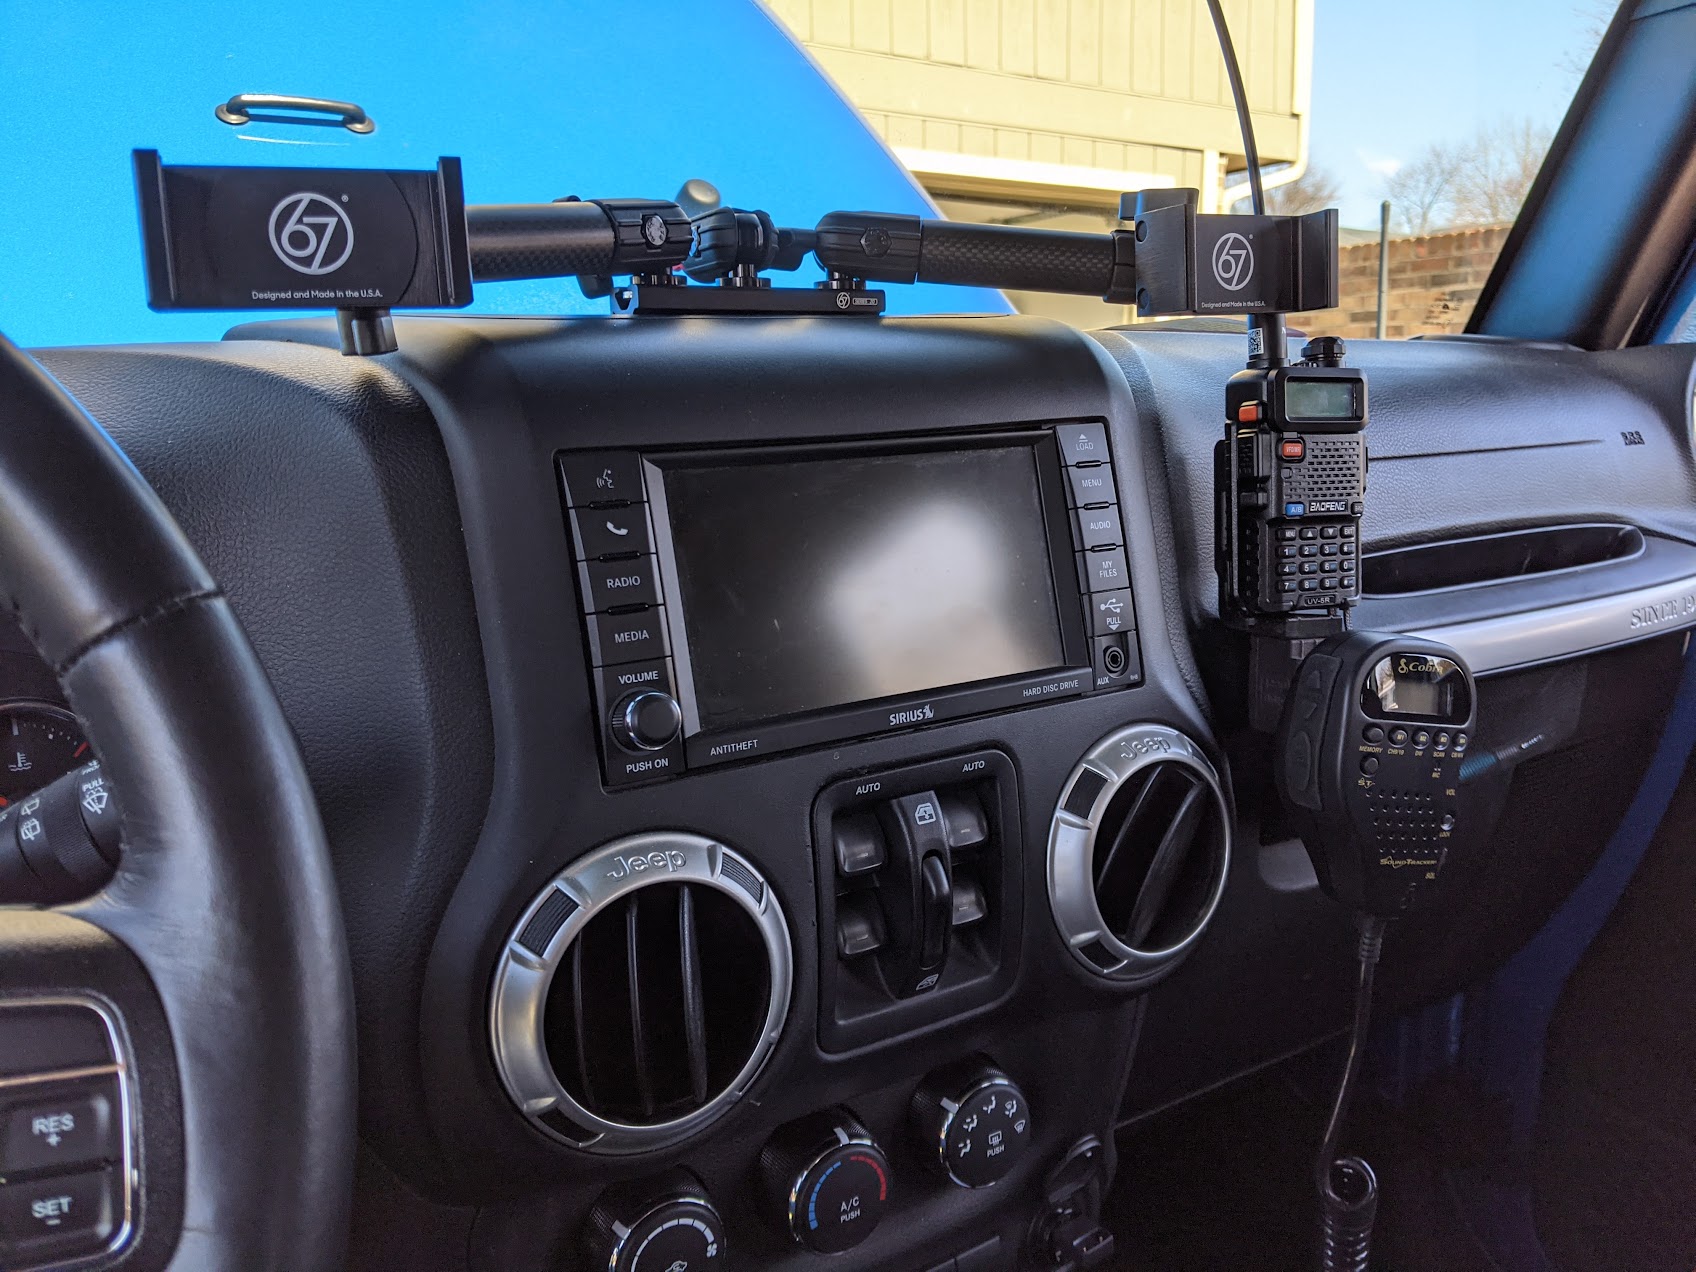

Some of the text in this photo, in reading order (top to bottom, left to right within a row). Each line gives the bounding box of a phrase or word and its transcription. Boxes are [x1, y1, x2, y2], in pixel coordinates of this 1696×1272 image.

[1215, 234, 1250, 289] 67
[252, 289, 383, 300] Designed and Made in the U.S.A.
[1201, 301, 1222, 309] Designed
[1075, 442, 1094, 451] LOAD
[1081, 479, 1102, 488] MENU
[1310, 502, 1346, 512] BAOFENG
[1090, 520, 1111, 530] AUDIO
[1286, 530, 1296, 538] MENU
[1304, 547, 1309, 555] 2
[1324, 546, 1329, 554] 3
[1102, 560, 1113, 569] MY
[1100, 568, 1118, 578] FILES
[606, 576, 641, 588] RADIO
[1631, 595, 1696, 628] SINCE 19
[1106, 616, 1122, 625] PULL
[614, 630, 650, 644] MEDIA
[1409, 662, 1444, 674] Cobra
[618, 670, 659, 684] VOLUME
[1097, 676, 1110, 686] AUX
[1023, 680, 1079, 697] HARD DISC DRIVE
[889, 709, 924, 726] SIRIUS
[710, 739, 759, 756] ANTITHEFT
[1120, 736, 1171, 760] Jeep
[1359, 746, 1383, 754] MEMORY
[626, 758, 669, 774] PUSH ON
[962, 760, 985, 772] AUTO
[82, 778, 104, 792] PULL
[855, 782, 881, 795] AUTO
[606, 850, 687, 882] Jeep
[32, 1112, 75, 1135] RES
[987, 1144, 1004, 1158] PUSH
[32, 1196, 72, 1218] SET
[840, 1196, 860, 1212] A/C
[840, 1209, 860, 1223] PUSH
